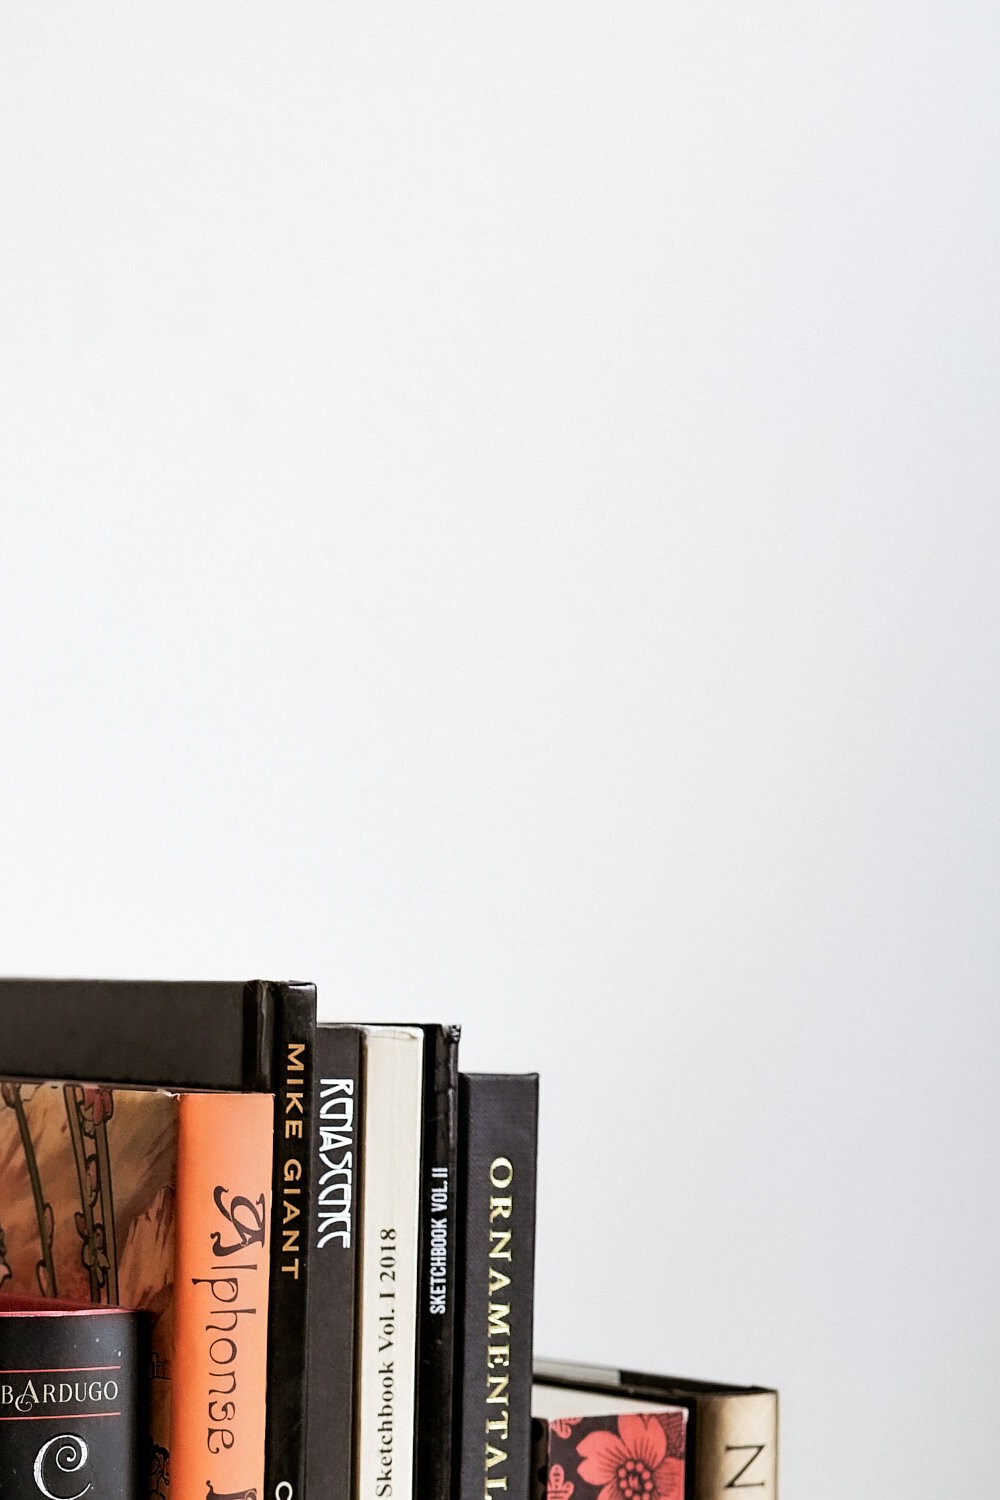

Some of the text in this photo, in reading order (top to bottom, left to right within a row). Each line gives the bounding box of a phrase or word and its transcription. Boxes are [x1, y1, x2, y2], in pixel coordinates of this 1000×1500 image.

[281, 1043, 306, 1280] MIKE GIANT
[379, 1228, 397, 1282] 2018
[430, 1218, 448, 1315] SKETCHBOOK
[191, 1185, 266, 1455] Alphonse
[378, 1308, 396, 1352] Vol.
[1, 1379, 119, 1413] BARDUGO
[375, 1360, 394, 1498] Sketchbook
